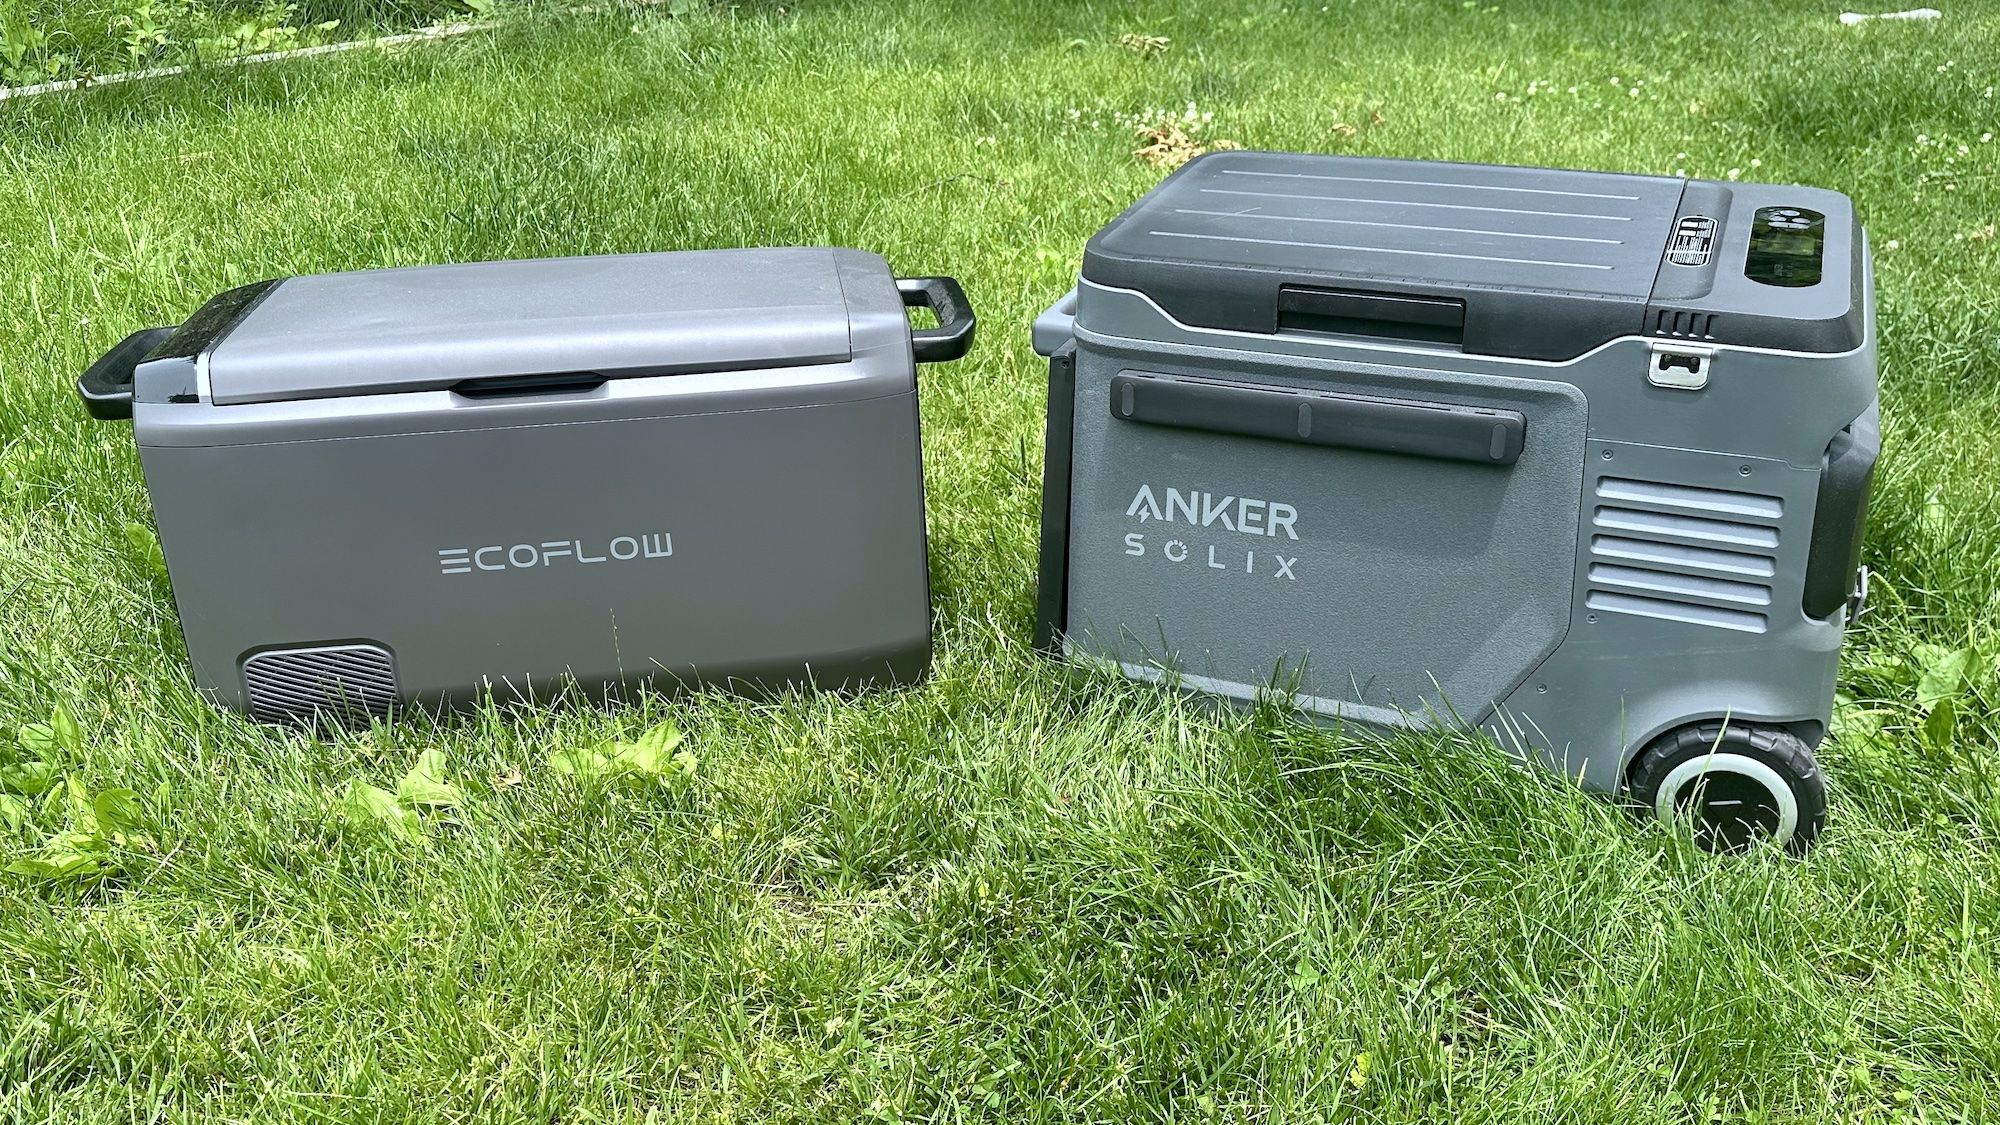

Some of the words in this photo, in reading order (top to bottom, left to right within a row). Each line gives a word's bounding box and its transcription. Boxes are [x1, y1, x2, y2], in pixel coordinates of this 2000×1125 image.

[1126, 484, 1299, 541] ANKER
[439, 533, 673, 574] ECOFLOW
[1124, 533, 1298, 580] SOLIX
